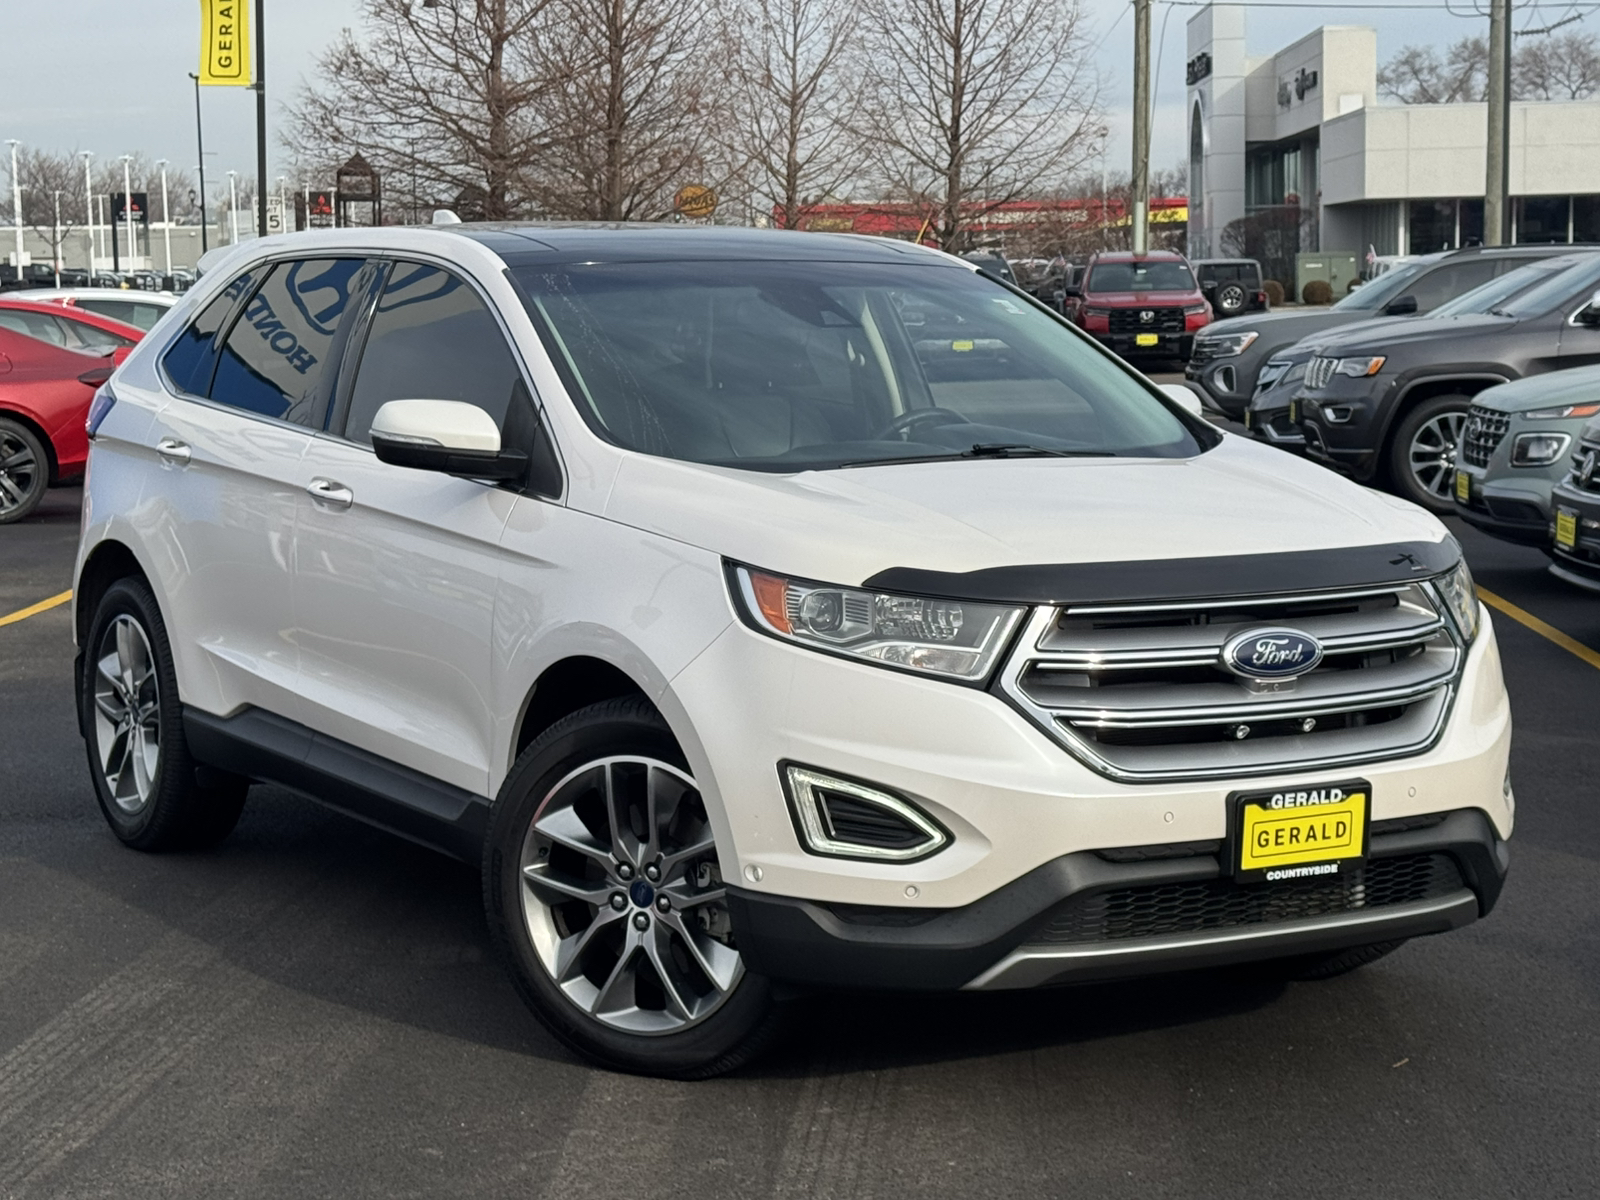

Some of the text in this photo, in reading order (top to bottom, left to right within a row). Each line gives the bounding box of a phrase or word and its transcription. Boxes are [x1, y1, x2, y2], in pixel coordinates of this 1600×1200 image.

[218, 0, 233, 68] GERA
[1252, 639, 1304, 665] Ford
[1271, 788, 1343, 809] GERALD
[1257, 820, 1347, 848] GERALD
[1266, 864, 1339, 881] COUNTRYSIDE
